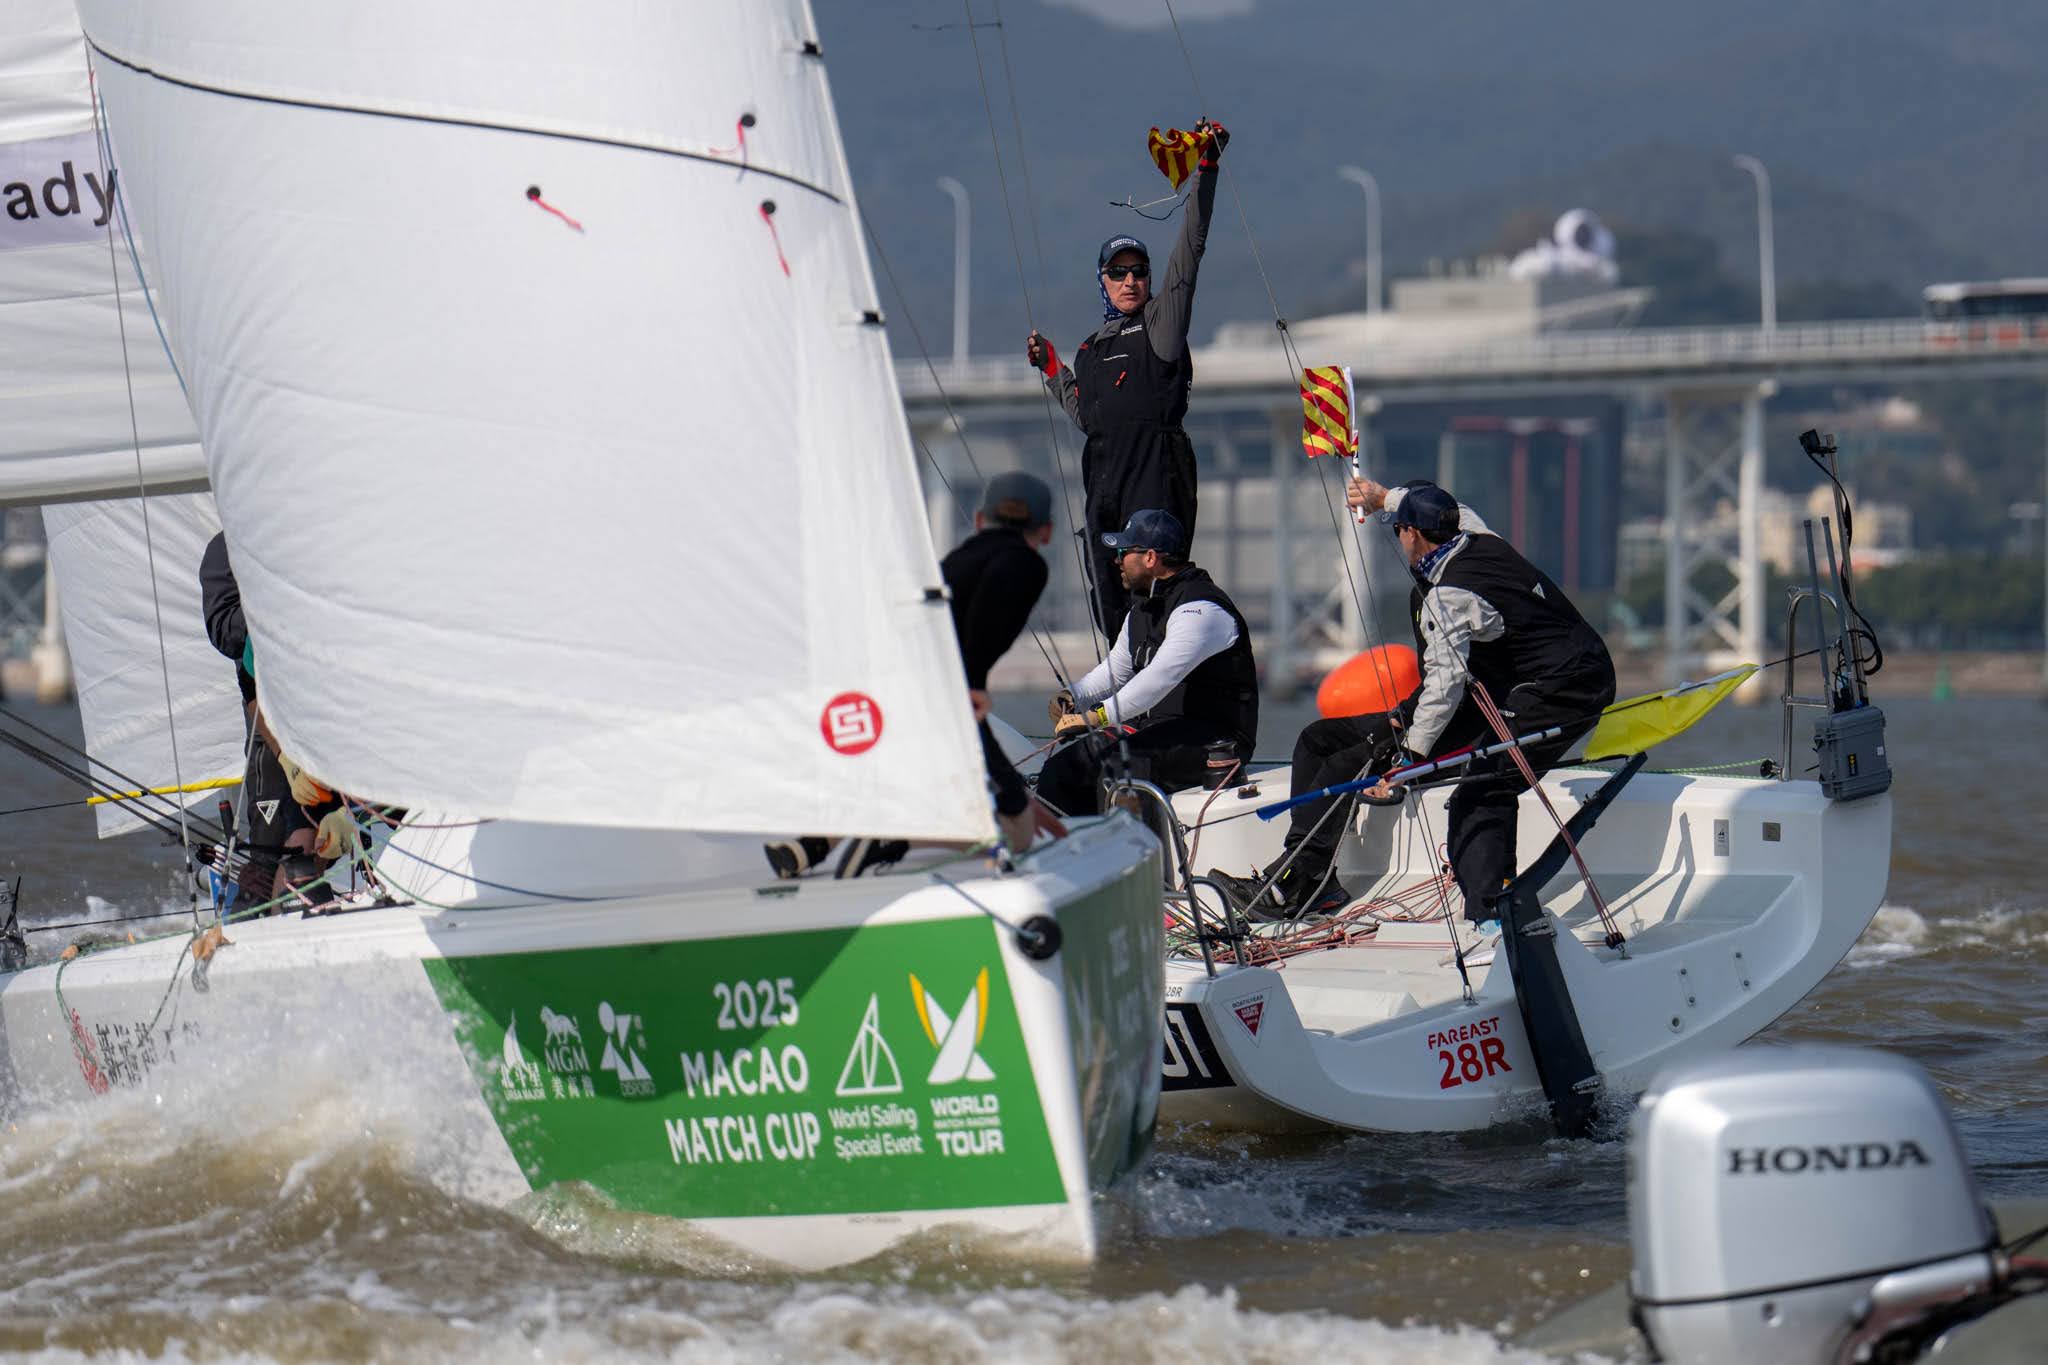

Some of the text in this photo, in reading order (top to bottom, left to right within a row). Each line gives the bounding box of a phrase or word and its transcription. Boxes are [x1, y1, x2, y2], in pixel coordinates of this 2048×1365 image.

[3, 160, 118, 227] ady
[713, 977, 800, 1030] 2025
[1428, 1016, 1499, 1050] FAREAST
[544, 1046, 590, 1072] MGM
[680, 1044, 810, 1099] MACAO
[1439, 1037, 1513, 1089] 28R
[827, 1103, 918, 1131] World Sailing
[930, 1094, 999, 1117] WORLD
[664, 1111, 821, 1165] MATCH CUP
[833, 1132, 924, 1162] Special Event
[936, 1129, 1005, 1157] TOUR
[1727, 1140, 1930, 1174] HONDA
